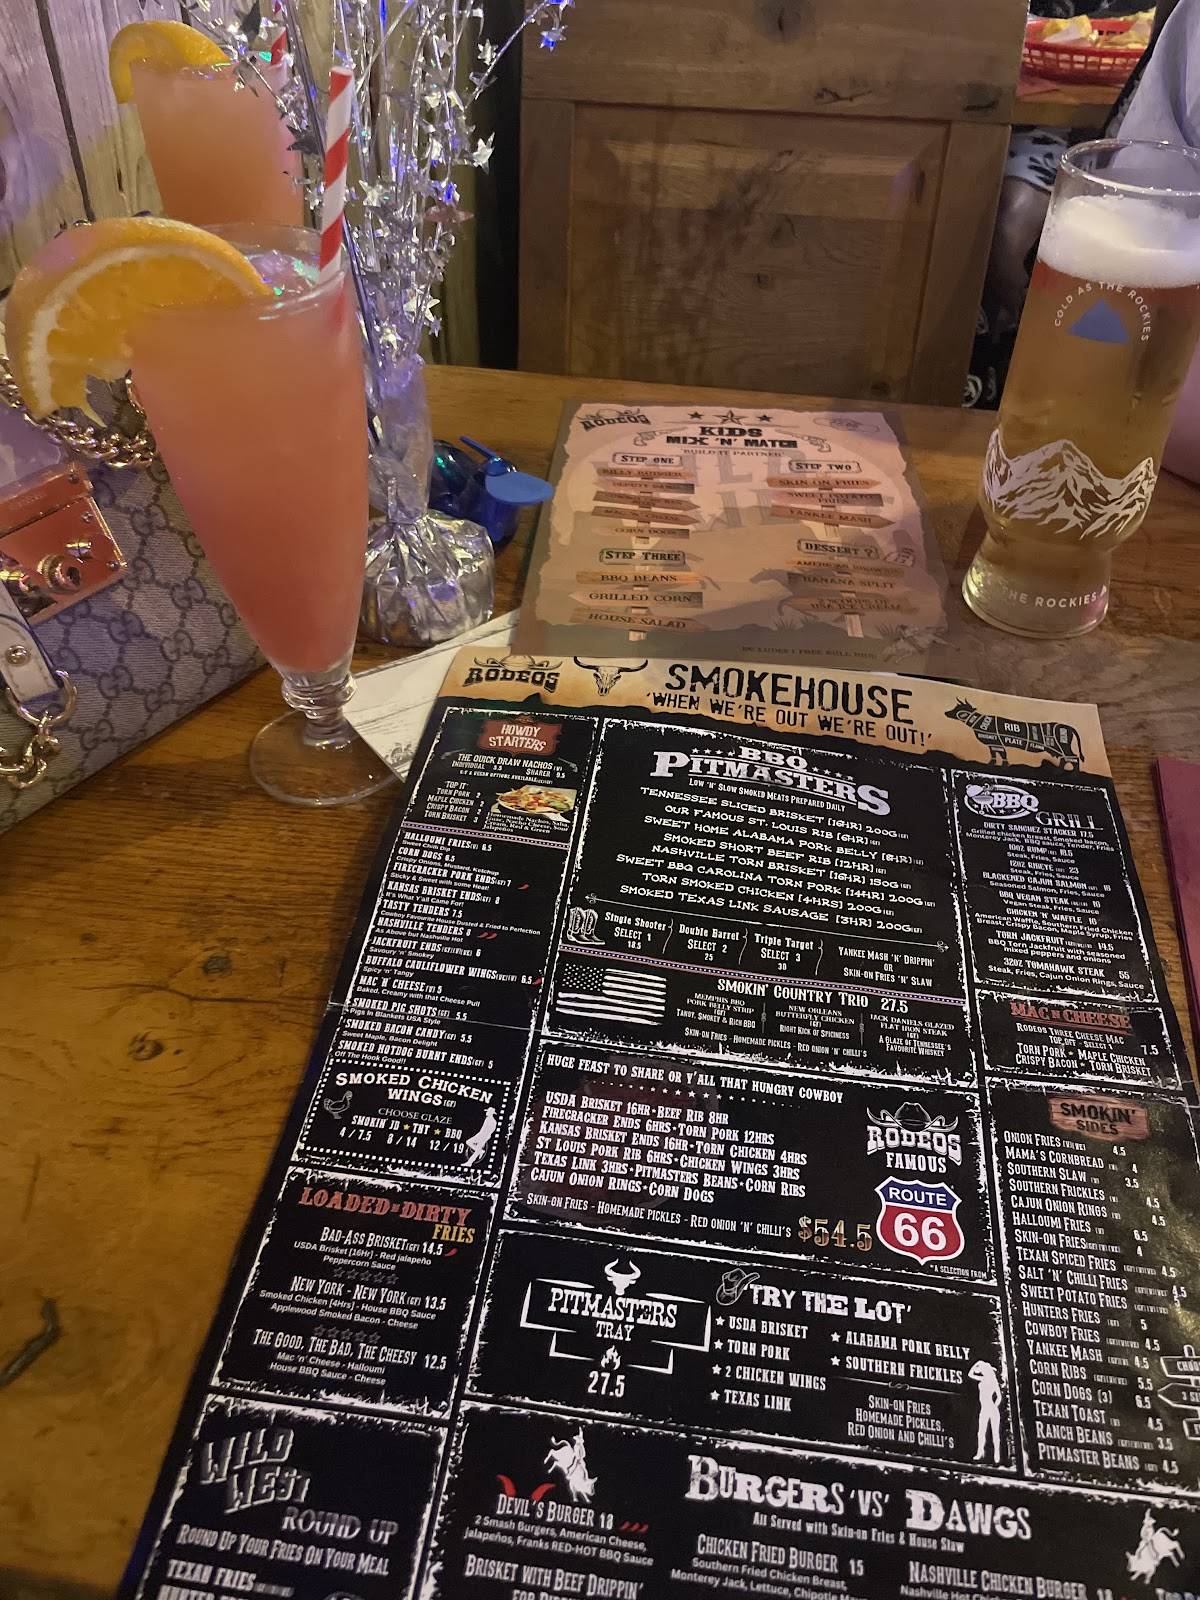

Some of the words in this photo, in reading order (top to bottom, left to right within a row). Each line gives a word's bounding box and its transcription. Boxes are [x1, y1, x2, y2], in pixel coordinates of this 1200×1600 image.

[1055, 295, 1073, 326] COLD
[1078, 283, 1091, 295] AS
[1099, 282, 1124, 292] THE
[1128, 290, 1151, 341] ROCKIES
[666, 435, 709, 446] MIX
[715, 438, 738, 447] 'N'
[744, 437, 798, 448] MATCH
[699, 426, 762, 437] KIDS
[621, 455, 647, 463] STEP
[789, 510, 834, 520] YANKEE
[839, 514, 872, 523] MASH
[605, 551, 635, 559] STEP
[642, 552, 681, 561] THREE
[805, 543, 860, 554] DESSERT
[589, 593, 648, 601] GRILLED
[1035, 592, 1097, 608] ROCKIES
[588, 613, 633, 623] HOUSE
[640, 618, 686, 628] SALAD
[462, 668, 560, 694] RODEOS
[665, 663, 914, 725] SMOKEHOUSE
[501, 724, 541, 737] HOWDY
[646, 692, 700, 711] 'WHEN
[710, 698, 766, 722] WE'RE
[775, 710, 808, 728] OUT
[817, 715, 876, 738] WE'RE
[885, 724, 932, 747] OUT!'
[1004, 723, 1020, 733] RIB
[489, 736, 546, 752] STARTERS
[1004, 736, 1023, 746] PLATE
[457, 754, 472, 762] THE
[473, 755, 495, 764] QUICK
[497, 757, 521, 766] DRAW
[522, 758, 553, 769] NACHOS
[738, 746, 809, 771] BBQ
[649, 751, 890, 816] PITMASTERS
[688, 778, 705, 788] LOW
[707, 780, 716, 789] 'N'
[718, 782, 737, 793] SLOW
[738, 786, 765, 799] SMOKED
[766, 790, 789, 804] MEATS
[791, 796, 824, 810] PREPARED
[826, 802, 845, 813] DAILY
[640, 786, 718, 805] TENNESSEE
[720, 798, 766, 814] SLICED
[769, 806, 825, 825] BRISKET
[991, 792, 1039, 812] BBQ
[1035, 811, 1103, 830] GRILL
[404, 831, 445, 845] HALLOUMI
[447, 838, 471, 850] FRIES
[481, 843, 492, 852] 6.5
[397, 847, 420, 856] CORN
[421, 851, 443, 860] DOGS
[445, 854, 456, 862] 6.5
[382, 899, 410, 912] TASTY
[412, 904, 450, 917] TENDERS
[452, 910, 463, 918] 7.5
[620, 885, 674, 900] SMOKED
[678, 892, 725, 907] TEXAS
[729, 899, 759, 912] LINK
[763, 904, 829, 922] SAUSAGE
[679, 923, 709, 938] Double
[711, 930, 739, 941] Barrel
[754, 932, 782, 948] Triple
[784, 939, 814, 951] Target
[717, 978, 770, 998] SMOKIN'
[773, 984, 834, 1006] COUNTRY
[837, 992, 869, 1008] TRIO
[880, 997, 909, 1014] 27.5
[1010, 1001, 1049, 1019] MAC
[1063, 1010, 1132, 1029] CHEESE
[1016, 1023, 1048, 1034] RODEOS
[1049, 1027, 1074, 1040] THREE
[1075, 1031, 1104, 1043] CHEESE
[1105, 1035, 1124, 1045] MAC
[1140, 1044, 1159, 1056] 7.5
[336, 1072, 411, 1087] SMOKED
[418, 1076, 494, 1104] CHICKEN
[547, 1054, 574, 1070] HUGE
[578, 1059, 609, 1075] FEAST
[614, 1064, 627, 1077] TO
[631, 1067, 665, 1082] SHARE
[668, 1072, 682, 1084] OR
[685, 1070, 716, 1087] Y'ALL
[720, 1077, 748, 1091] THAT
[752, 1080, 794, 1097] HUNGRY
[798, 1087, 844, 1104] COWBOY
[387, 1089, 443, 1107] WINGS
[1060, 1103, 1135, 1124] SMOKIN'
[1076, 1119, 1119, 1135] SIDES
[867, 1125, 962, 1166] RODEOS
[1003, 1131, 1033, 1145] ONION
[1034, 1133, 1061, 1148] FRIES
[886, 1152, 947, 1174] FAMOUS
[1005, 1146, 1046, 1162] MAMA'S
[1048, 1150, 1104, 1169] CORNBREAD
[299, 1187, 390, 1217] LOADED
[400, 1201, 472, 1227] DIRTY
[889, 1187, 947, 1207] ROUTE
[320, 1227, 365, 1246] BAD-ASS
[366, 1233, 406, 1251] BRISKET
[432, 1224, 476, 1244] FRIES
[798, 1216, 873, 1252] $54.5
[893, 1212, 947, 1251] 66
[323, 1255, 370, 1270] Peppercorn
[371, 1260, 397, 1271] Sauce
[547, 1288, 677, 1329] PITMASTERS
[802, 1290, 848, 1316] THE
[854, 1297, 912, 1324] LOT'
[596, 1320, 634, 1342] TRAY
[252, 1329, 274, 1346] THE
[275, 1331, 305, 1351] GOOD,
[308, 1336, 327, 1354] THE
[329, 1339, 353, 1357] BAD,
[357, 1343, 376, 1360] THE
[379, 1346, 417, 1366] CHEESY
[424, 1354, 447, 1371] 12.5
[846, 1330, 898, 1351] ALABAMA
[902, 1338, 930, 1356] PORK
[935, 1343, 970, 1361] BELLY
[846, 1355, 905, 1378] SOUTHERN
[909, 1362, 963, 1385] FRICKLES
[587, 1370, 626, 1398] 27.5
[1033, 1400, 1070, 1419] TEXAN
[1071, 1405, 1106, 1424] TOAST
[200, 1428, 295, 1485] WILD
[1038, 1443, 1100, 1466] PITMASTER
[1102, 1450, 1140, 1471] BEANS
[224, 1466, 312, 1515] WEST
[684, 1454, 845, 1516] BURGERS
[850, 1489, 890, 1518] 'VS'
[495, 1493, 546, 1519] DEVIL'S
[547, 1502, 595, 1528] BURGER
[599, 1513, 614, 1531] 18
[905, 1488, 1032, 1540] DAWGS
[281, 1505, 362, 1540] ROUND
[367, 1518, 399, 1546] UP
